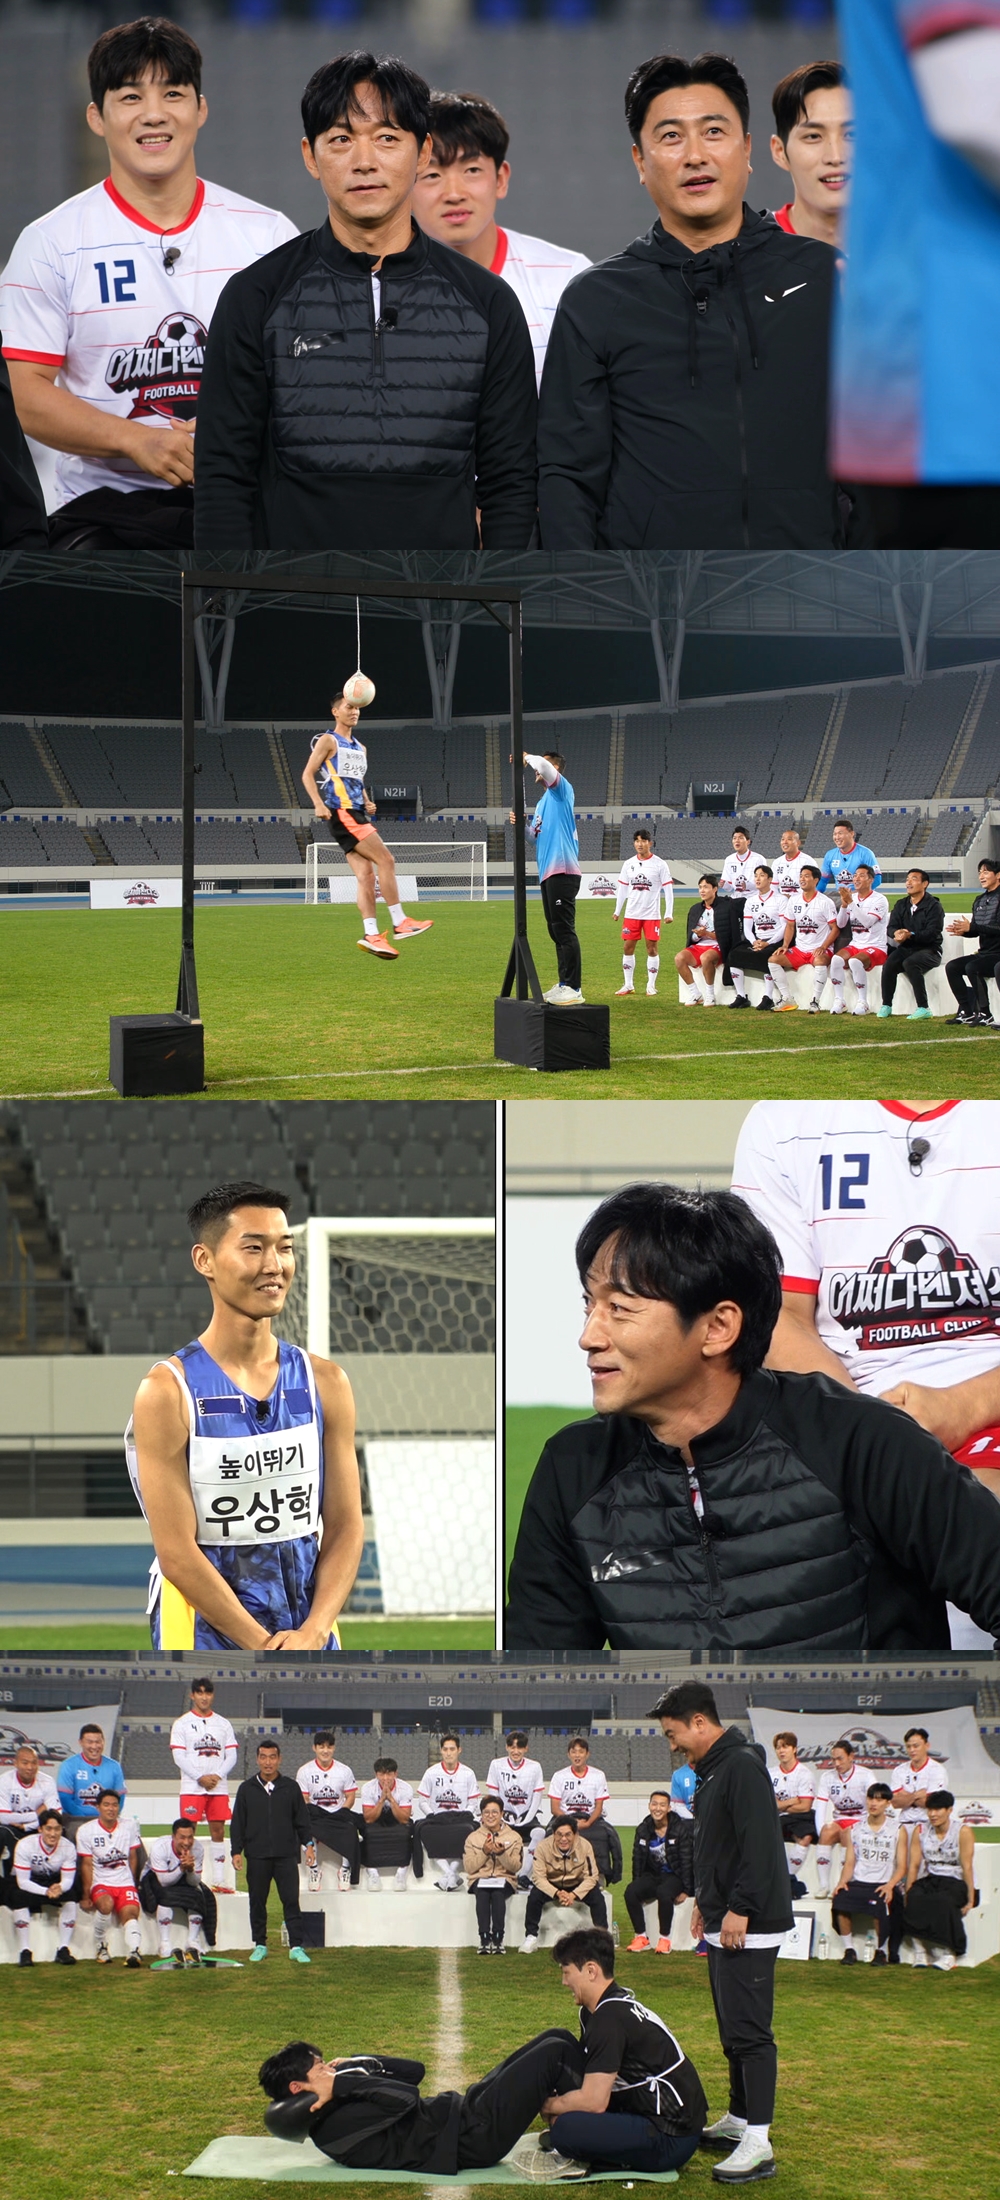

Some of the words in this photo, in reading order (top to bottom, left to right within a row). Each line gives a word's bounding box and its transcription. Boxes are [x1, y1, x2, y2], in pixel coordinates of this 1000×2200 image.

[94, 259, 136, 304] 12
[144, 384, 198, 401] FOOTBALL
[384, 787, 406, 797] N2H
[704, 783, 725, 793] N2J
[751, 905, 759, 913] 22
[794, 905, 802, 914] 99
[654, 926, 660, 936] 4
[819, 1153, 870, 1211] 12
[868, 1322, 940, 1343] FOOTBALL
[218, 1443, 305, 1480] 높이뛰기
[205, 1483, 313, 1537] 우상혁
[428, 1696, 453, 1707] E2D
[857, 1695, 882, 1706] E2F
[191, 1723, 198, 1732] 4
[76, 1770, 88, 1780] 23
[311, 1775, 320, 1784] 12
[500, 1772, 511, 1782] 77
[435, 1777, 444, 1787] 21
[564, 1781, 575, 1790] 20
[94, 1837, 105, 1848] 99
[32, 1855, 43, 1866] 22
